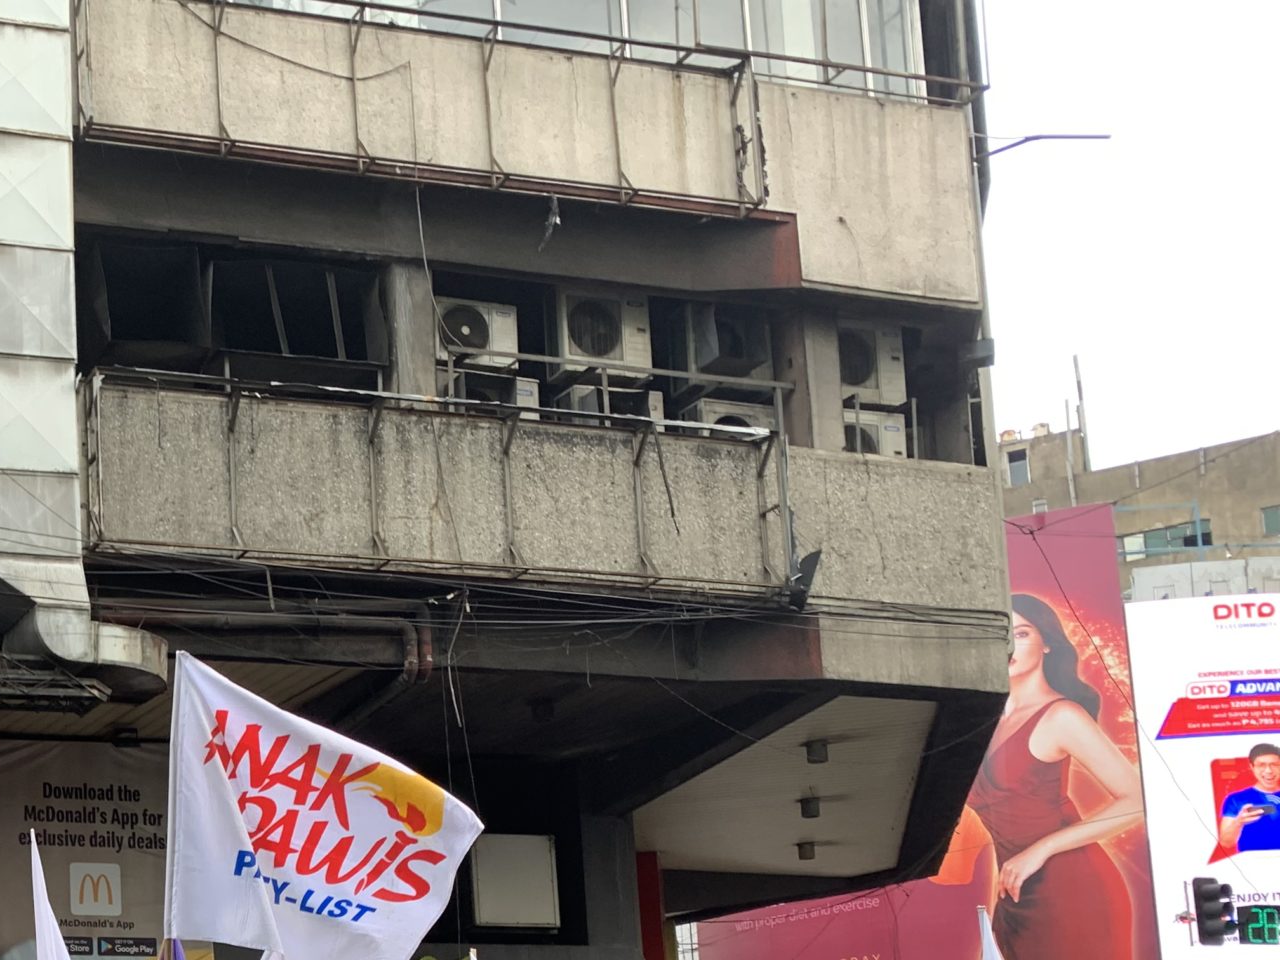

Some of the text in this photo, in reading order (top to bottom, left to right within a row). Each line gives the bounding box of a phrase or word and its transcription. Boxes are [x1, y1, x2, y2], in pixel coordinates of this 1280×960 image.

[1213, 602, 1275, 620] DITO
[1190, 684, 1228, 696] DITO
[42, 782, 141, 802] Download the
[111, 808, 139, 830] App
[142, 808, 163, 826] for
[89, 830, 124, 854] daily
[127, 831, 167, 850] deals
[735, 897, 880, 932] with proper diet and exercise
[116, 919, 135, 930] App
[69, 944, 90, 952] Store
[115, 944, 153, 954] Google Play
